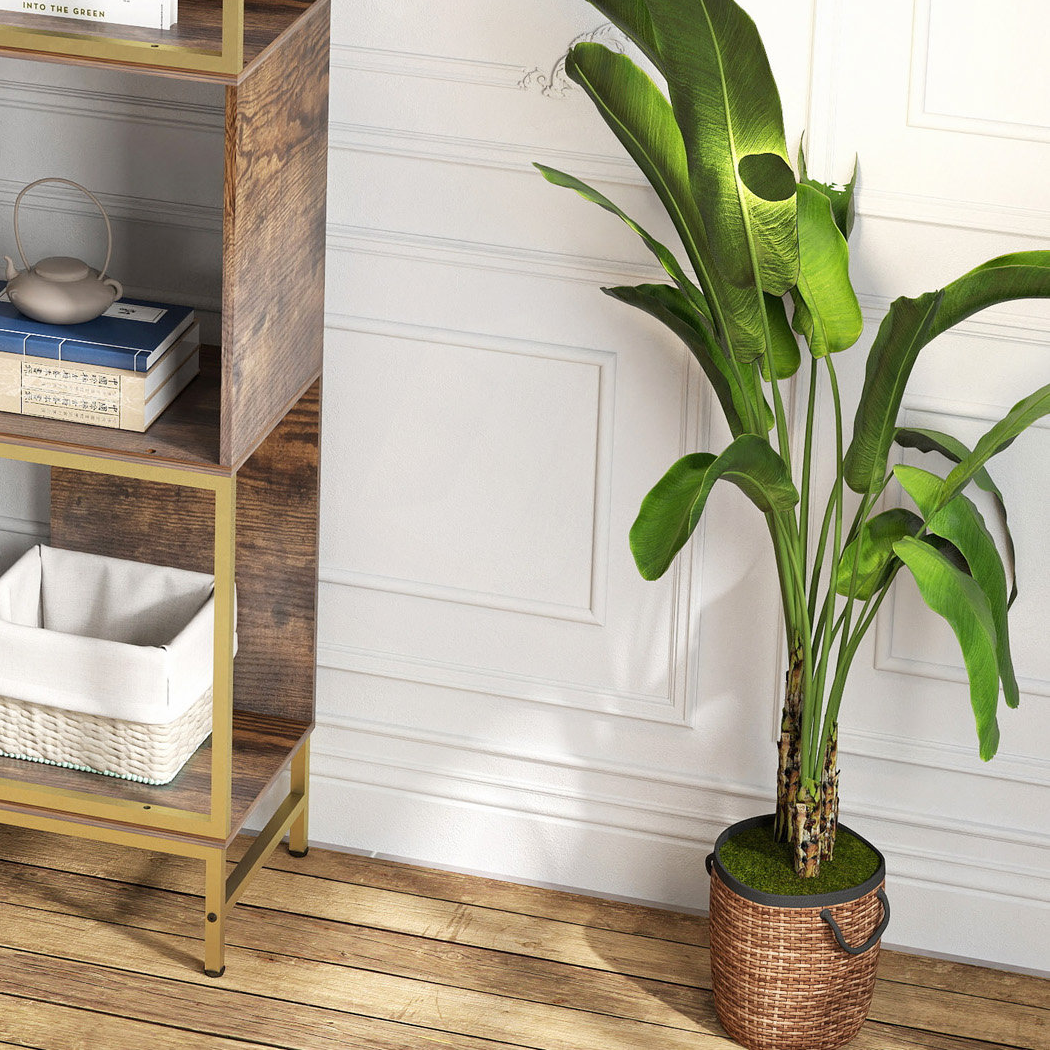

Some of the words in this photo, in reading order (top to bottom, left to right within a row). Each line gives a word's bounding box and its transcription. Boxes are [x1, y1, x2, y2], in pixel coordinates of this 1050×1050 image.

[23, 1, 46, 11] INTO
[50, 4, 69, 14] THE
[73, 7, 105, 18] GREEN
